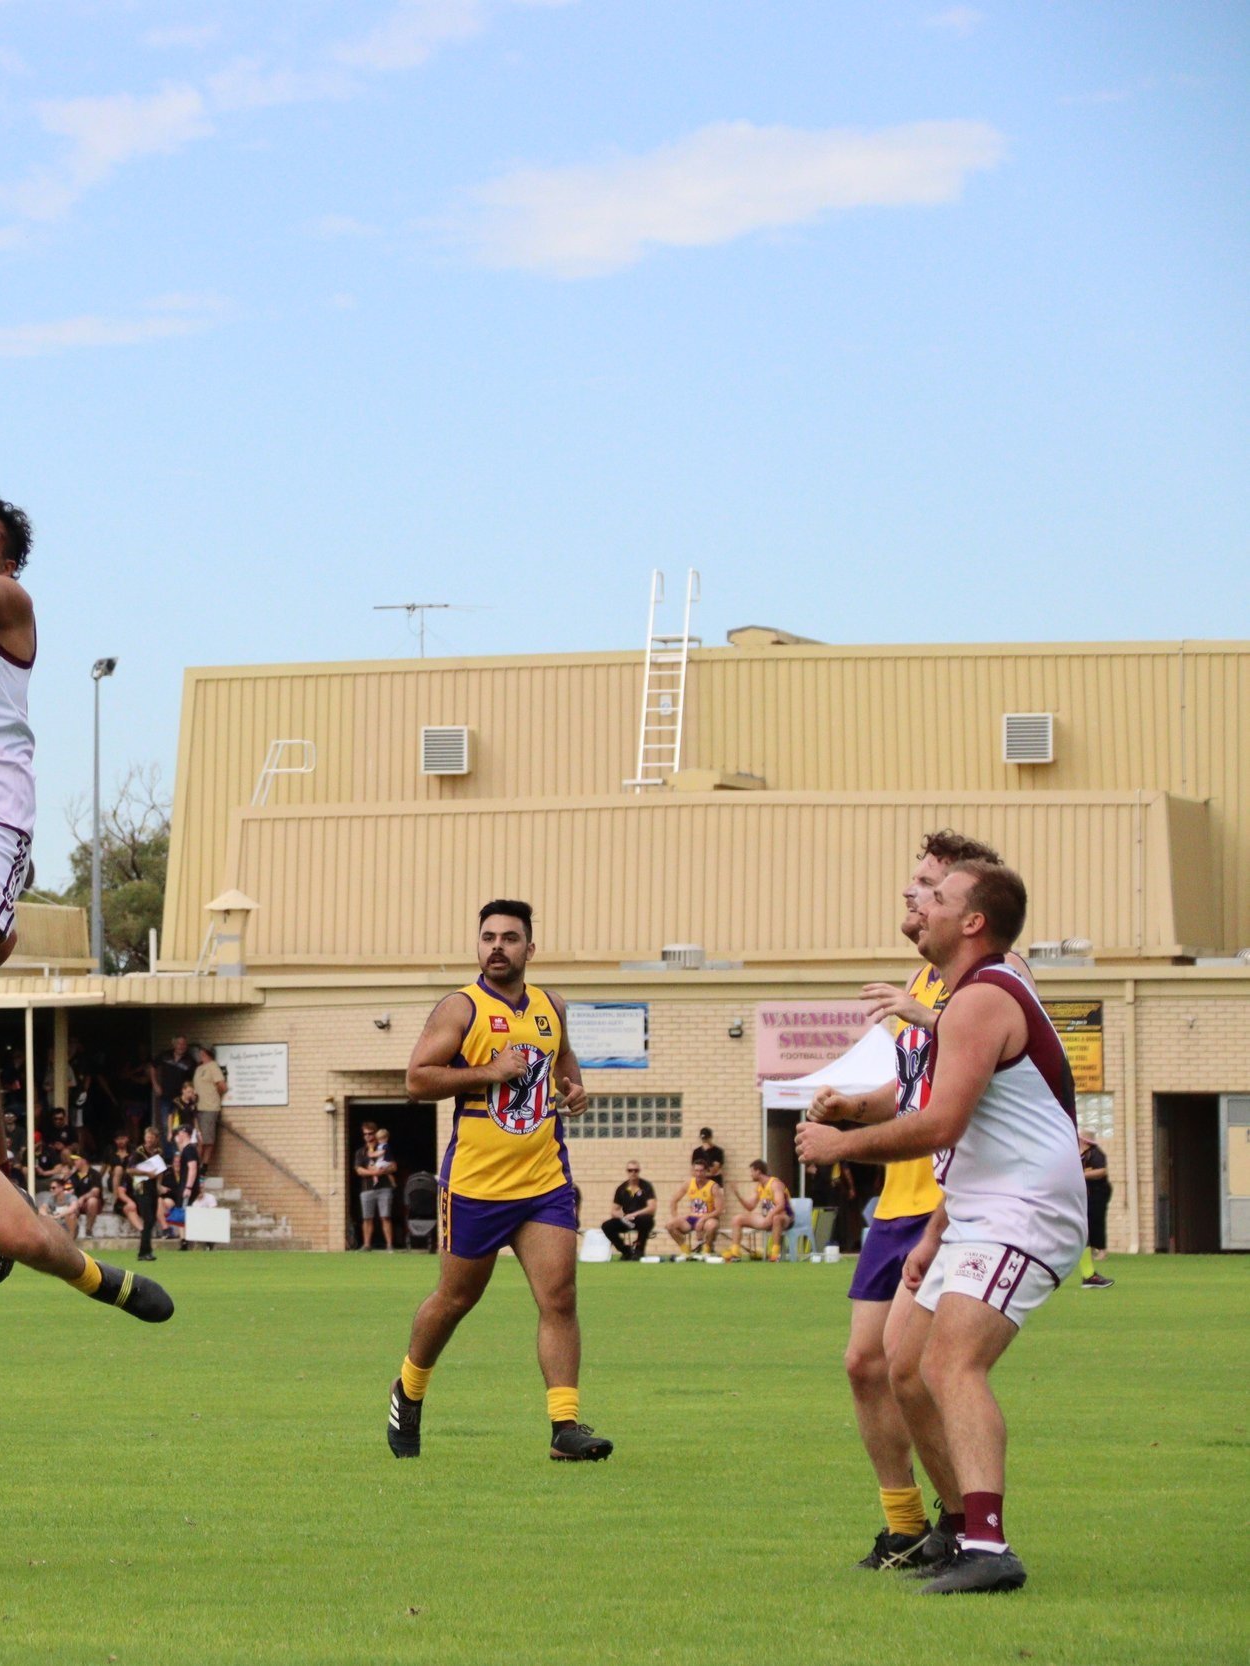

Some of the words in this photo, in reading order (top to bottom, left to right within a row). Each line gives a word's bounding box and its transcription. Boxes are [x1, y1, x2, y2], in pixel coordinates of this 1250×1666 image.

[761, 1011, 867, 1027] WARNBRO
[778, 1031, 850, 1048] SWANS
[780, 1052, 824, 1060] FOOTBALL
[826, 1052, 844, 1060] CLU
[503, 1123, 523, 1134] SWANS
[522, 1116, 545, 1134] FOOTBALL
